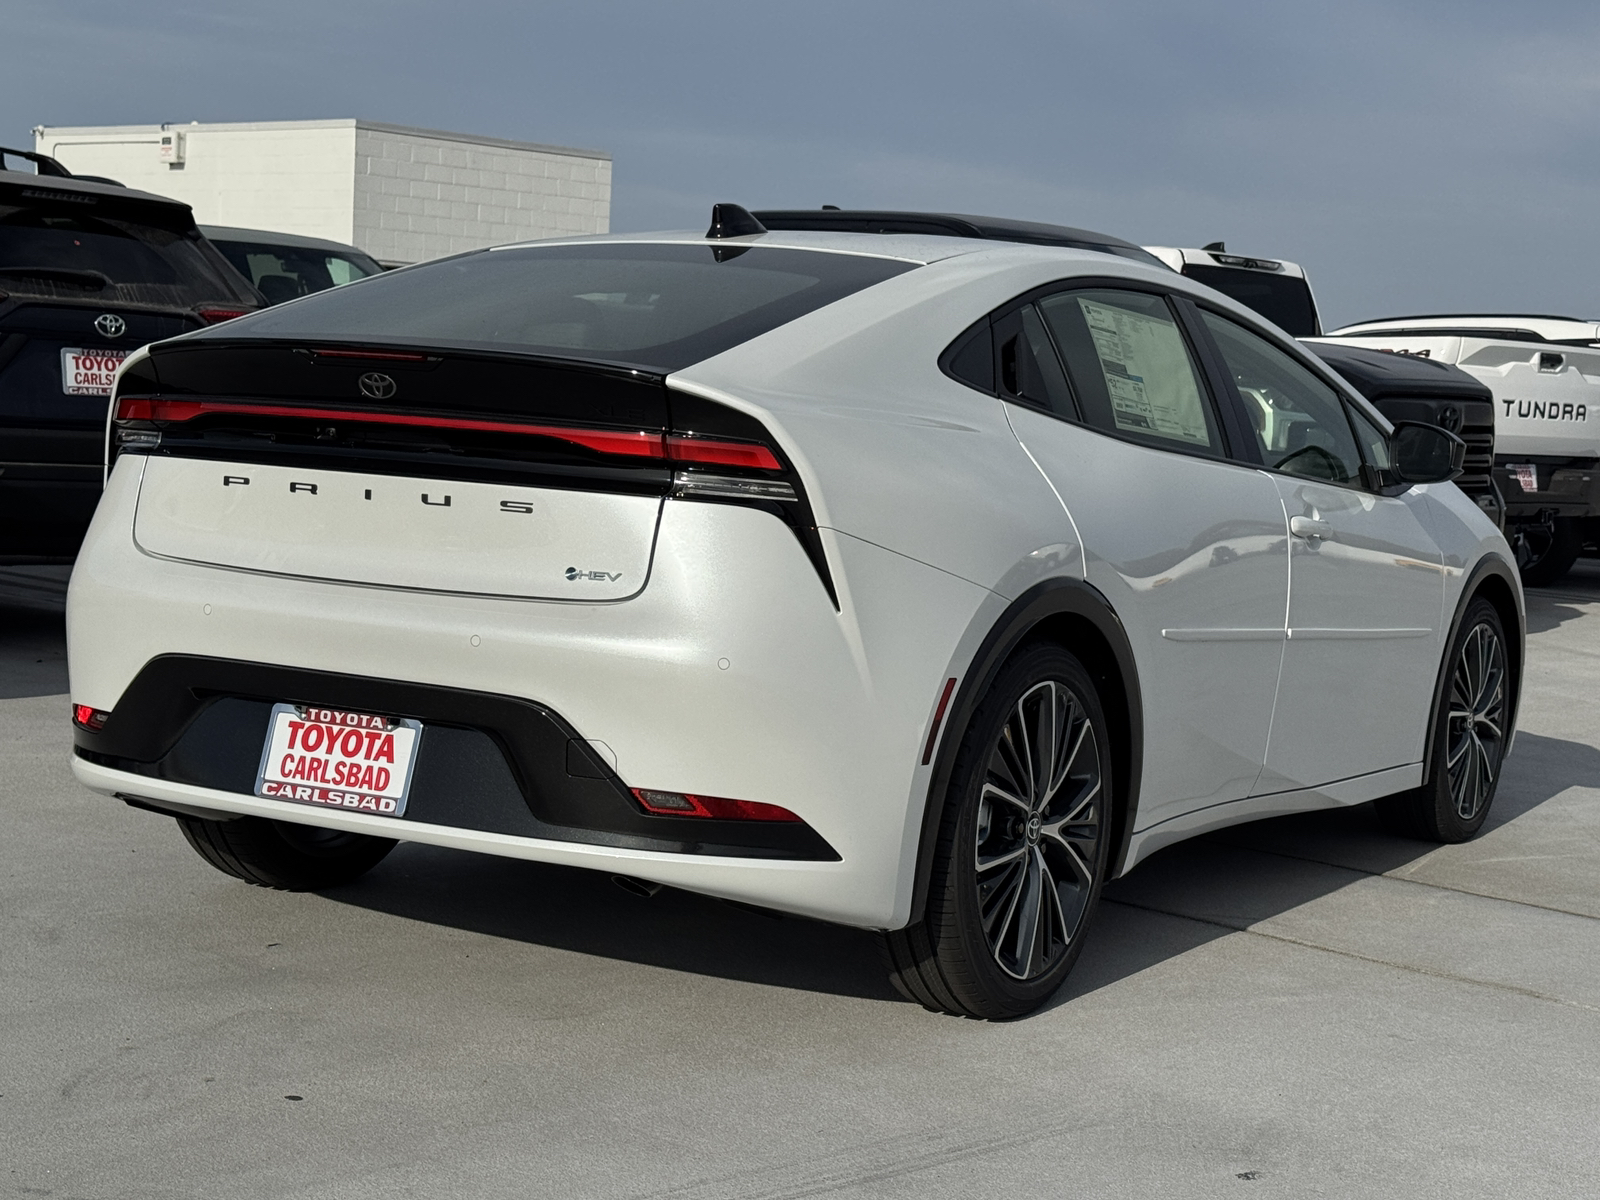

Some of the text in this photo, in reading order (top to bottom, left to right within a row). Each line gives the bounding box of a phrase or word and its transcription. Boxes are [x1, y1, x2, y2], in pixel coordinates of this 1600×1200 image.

[72, 355, 125, 372] TOYOT
[83, 349, 125, 357] TOYOTA
[74, 372, 117, 386] CARLS
[1502, 399, 1587, 421] TUNDRA
[223, 475, 534, 514] PRIUS
[578, 569, 623, 583] HEV
[309, 708, 384, 729] TOYOTA
[288, 720, 395, 764] TOYOTA
[280, 753, 391, 792] CARLSBAD
[261, 782, 397, 813] CARLSBAD
